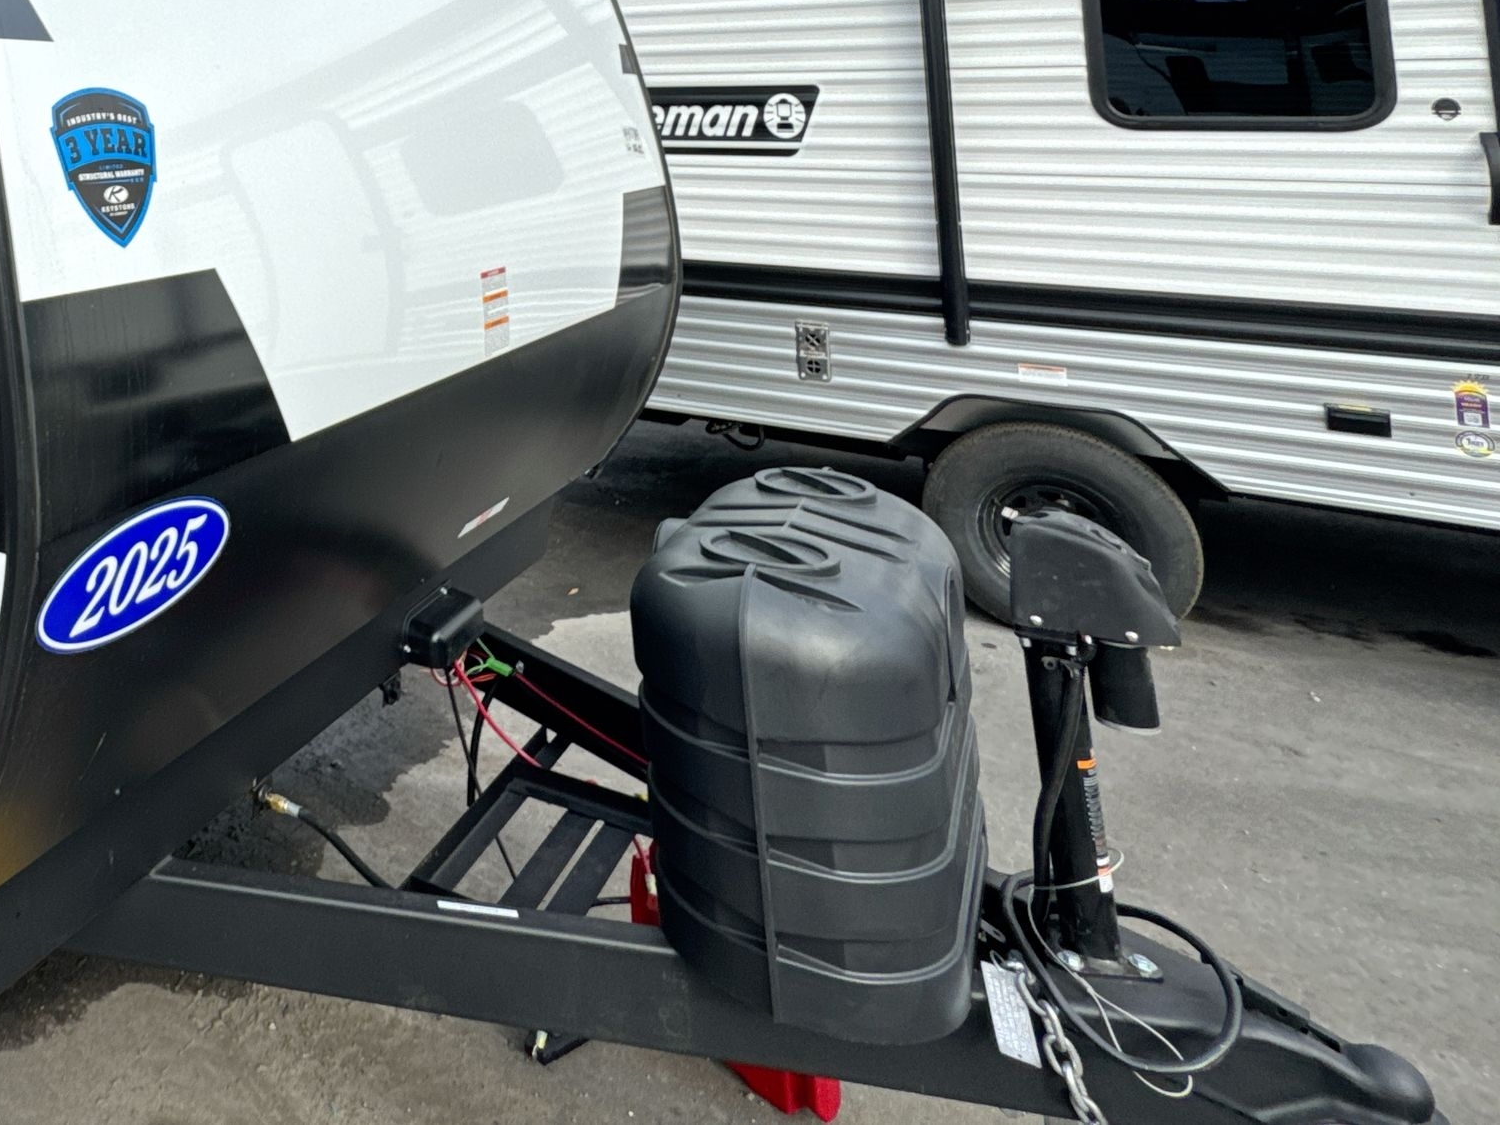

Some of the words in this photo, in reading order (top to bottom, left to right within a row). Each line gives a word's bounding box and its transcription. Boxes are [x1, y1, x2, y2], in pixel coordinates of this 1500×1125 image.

[66, 112, 115, 127] INDUSTRY'S
[116, 113, 137, 125] BEST
[651, 104, 759, 137] eman
[65, 136, 81, 163] 3
[83, 128, 148, 158] YEAR
[78, 171, 114, 181] STRUCTURAL
[114, 168, 144, 178] WARRANTY
[101, 203, 135, 212] KEYSTONE
[68, 513, 208, 638] 2025
